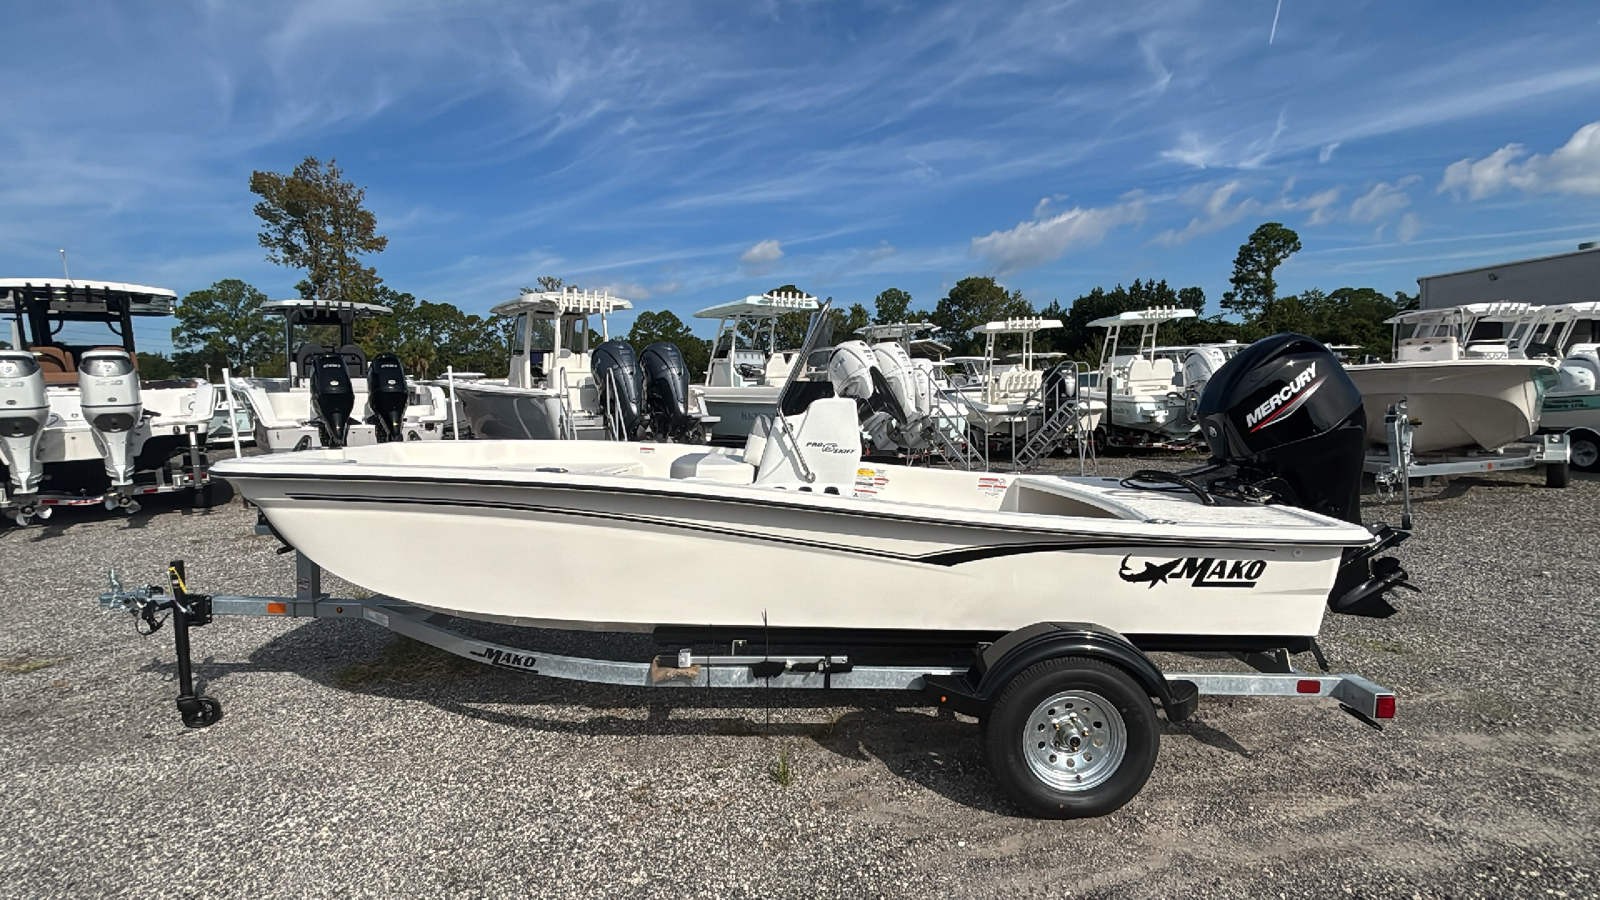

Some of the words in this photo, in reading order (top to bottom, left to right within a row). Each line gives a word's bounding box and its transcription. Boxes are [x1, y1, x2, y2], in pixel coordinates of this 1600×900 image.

[1245, 361, 1317, 428] MERCURY
[1168, 557, 1267, 588] MAKO
[469, 647, 539, 674] MAKO
